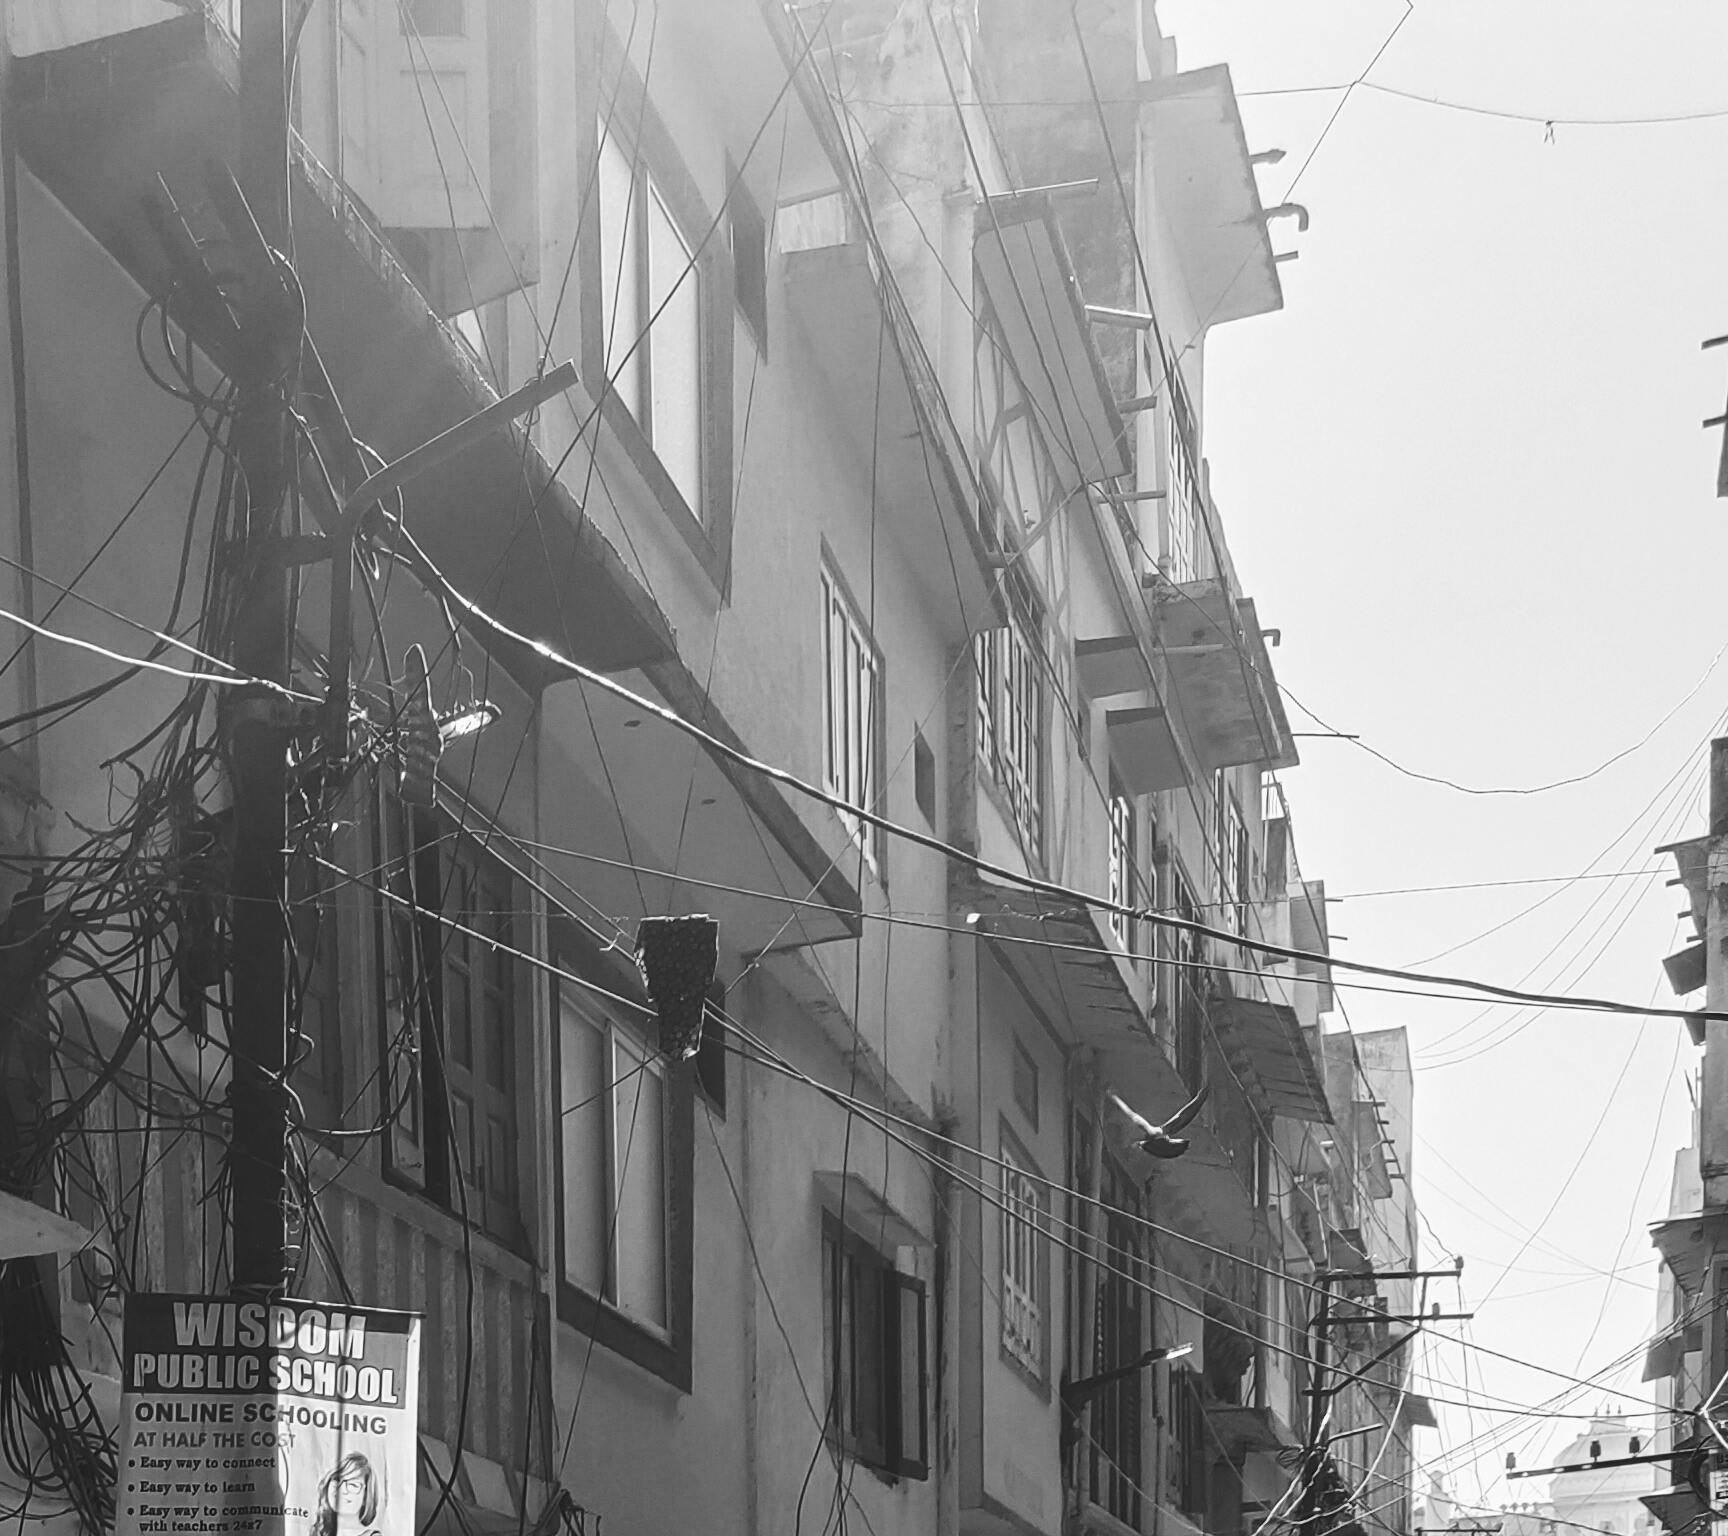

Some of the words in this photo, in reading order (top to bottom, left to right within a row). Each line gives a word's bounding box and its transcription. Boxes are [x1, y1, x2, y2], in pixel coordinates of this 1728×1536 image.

[172, 1301, 367, 1360] WISDOM
[133, 1353, 260, 1390] PUBLIC
[268, 1354, 398, 1405] SCHOOL
[135, 1402, 234, 1423] ONLINE
[243, 1403, 387, 1435] SCHOOLING
[133, 1431, 157, 1447] AT
[162, 1431, 208, 1448] HALF
[214, 1432, 245, 1448] THE
[251, 1431, 296, 1449] COST
[140, 1456, 172, 1471] Easy
[176, 1459, 201, 1471] way
[205, 1457, 219, 1468] to
[222, 1457, 275, 1468] connect
[139, 1481, 171, 1495] Easy
[175, 1484, 200, 1496] way
[204, 1482, 218, 1493] to
[222, 1482, 255, 1493] learn
[139, 1505, 171, 1518] Easy
[174, 1507, 199, 1519] way
[203, 1506, 217, 1516] to
[222, 1505, 309, 1518] communicate
[139, 1520, 168, 1532] with
[171, 1520, 228, 1532] teachers
